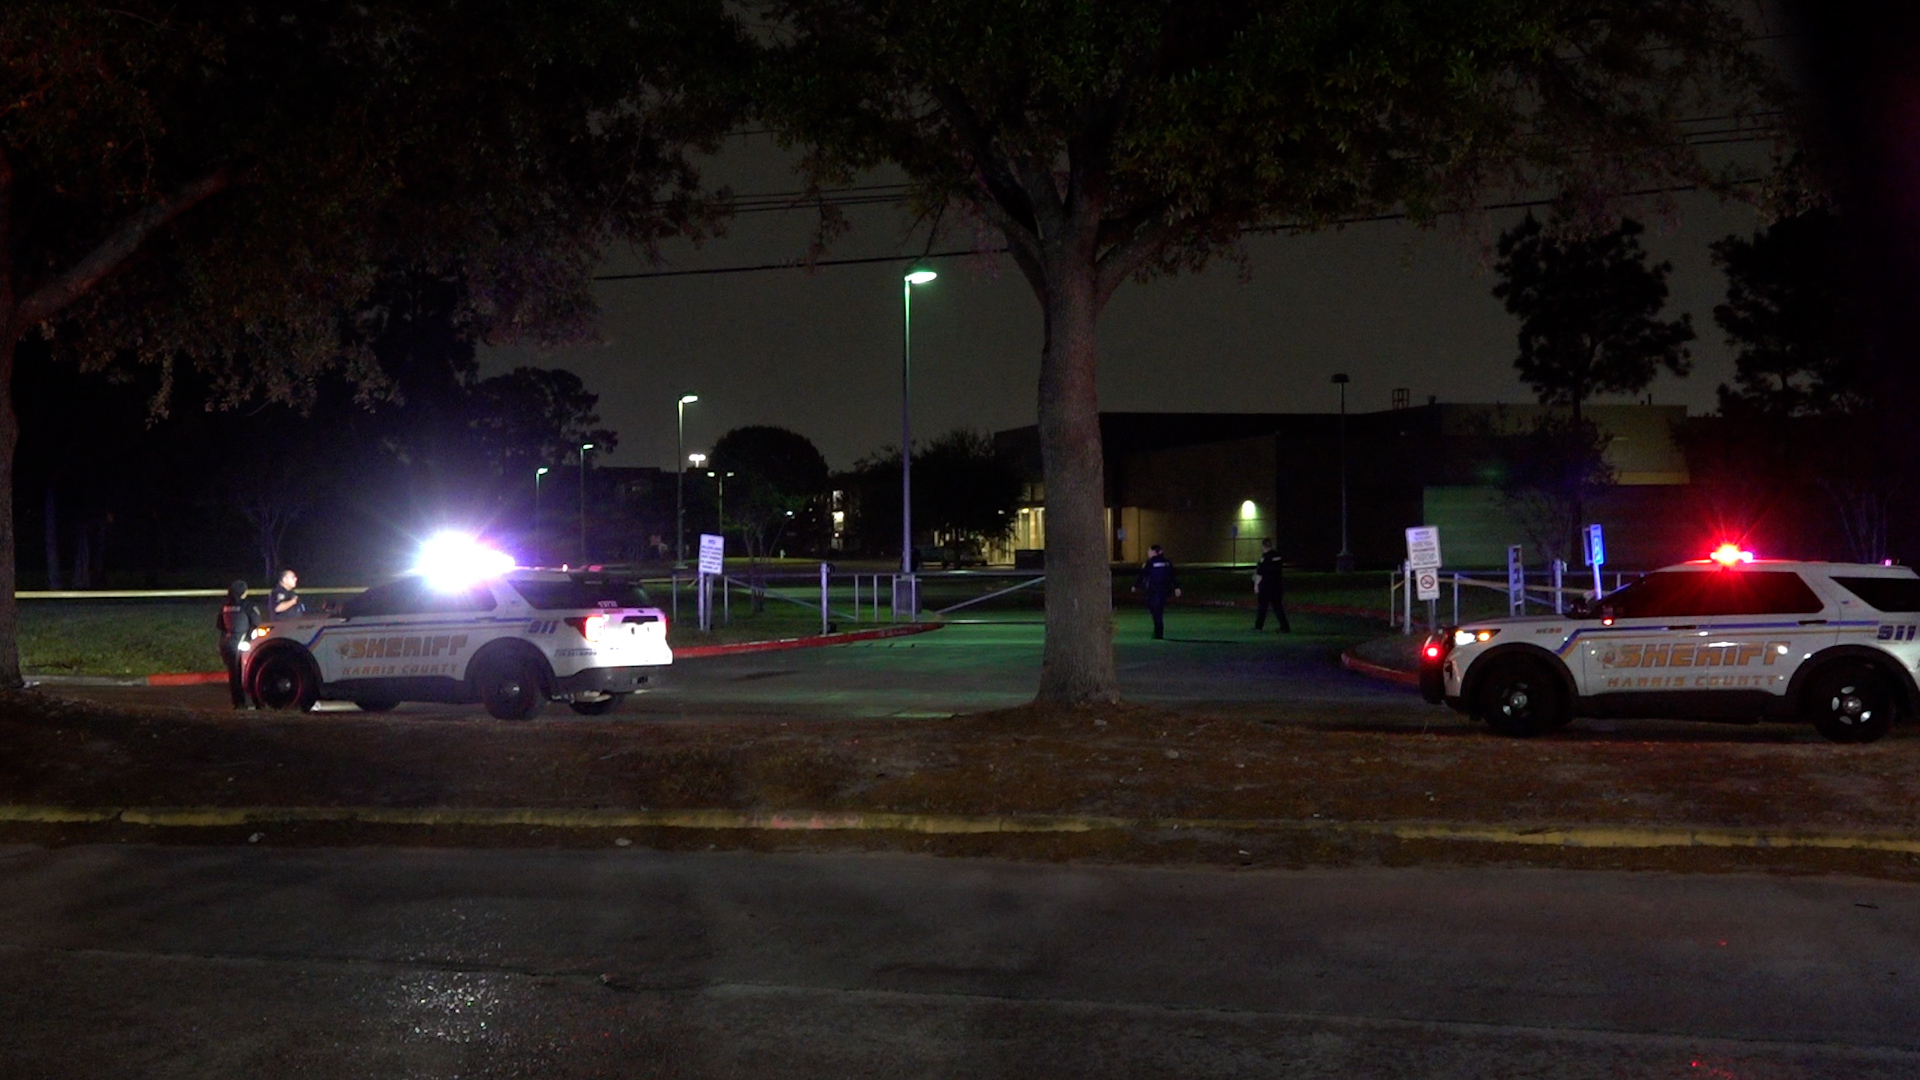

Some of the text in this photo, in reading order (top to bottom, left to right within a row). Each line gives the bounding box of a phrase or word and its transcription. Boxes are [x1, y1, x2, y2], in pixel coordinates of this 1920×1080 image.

[528, 620, 558, 634] 911
[1877, 625, 1916, 641] 911
[348, 635, 468, 659] SHERIFF
[1613, 641, 1790, 668] SHERIFF
[342, 663, 457, 676] HARRIS COUNTY
[1607, 675, 1777, 688] HARRIS COUNTY
